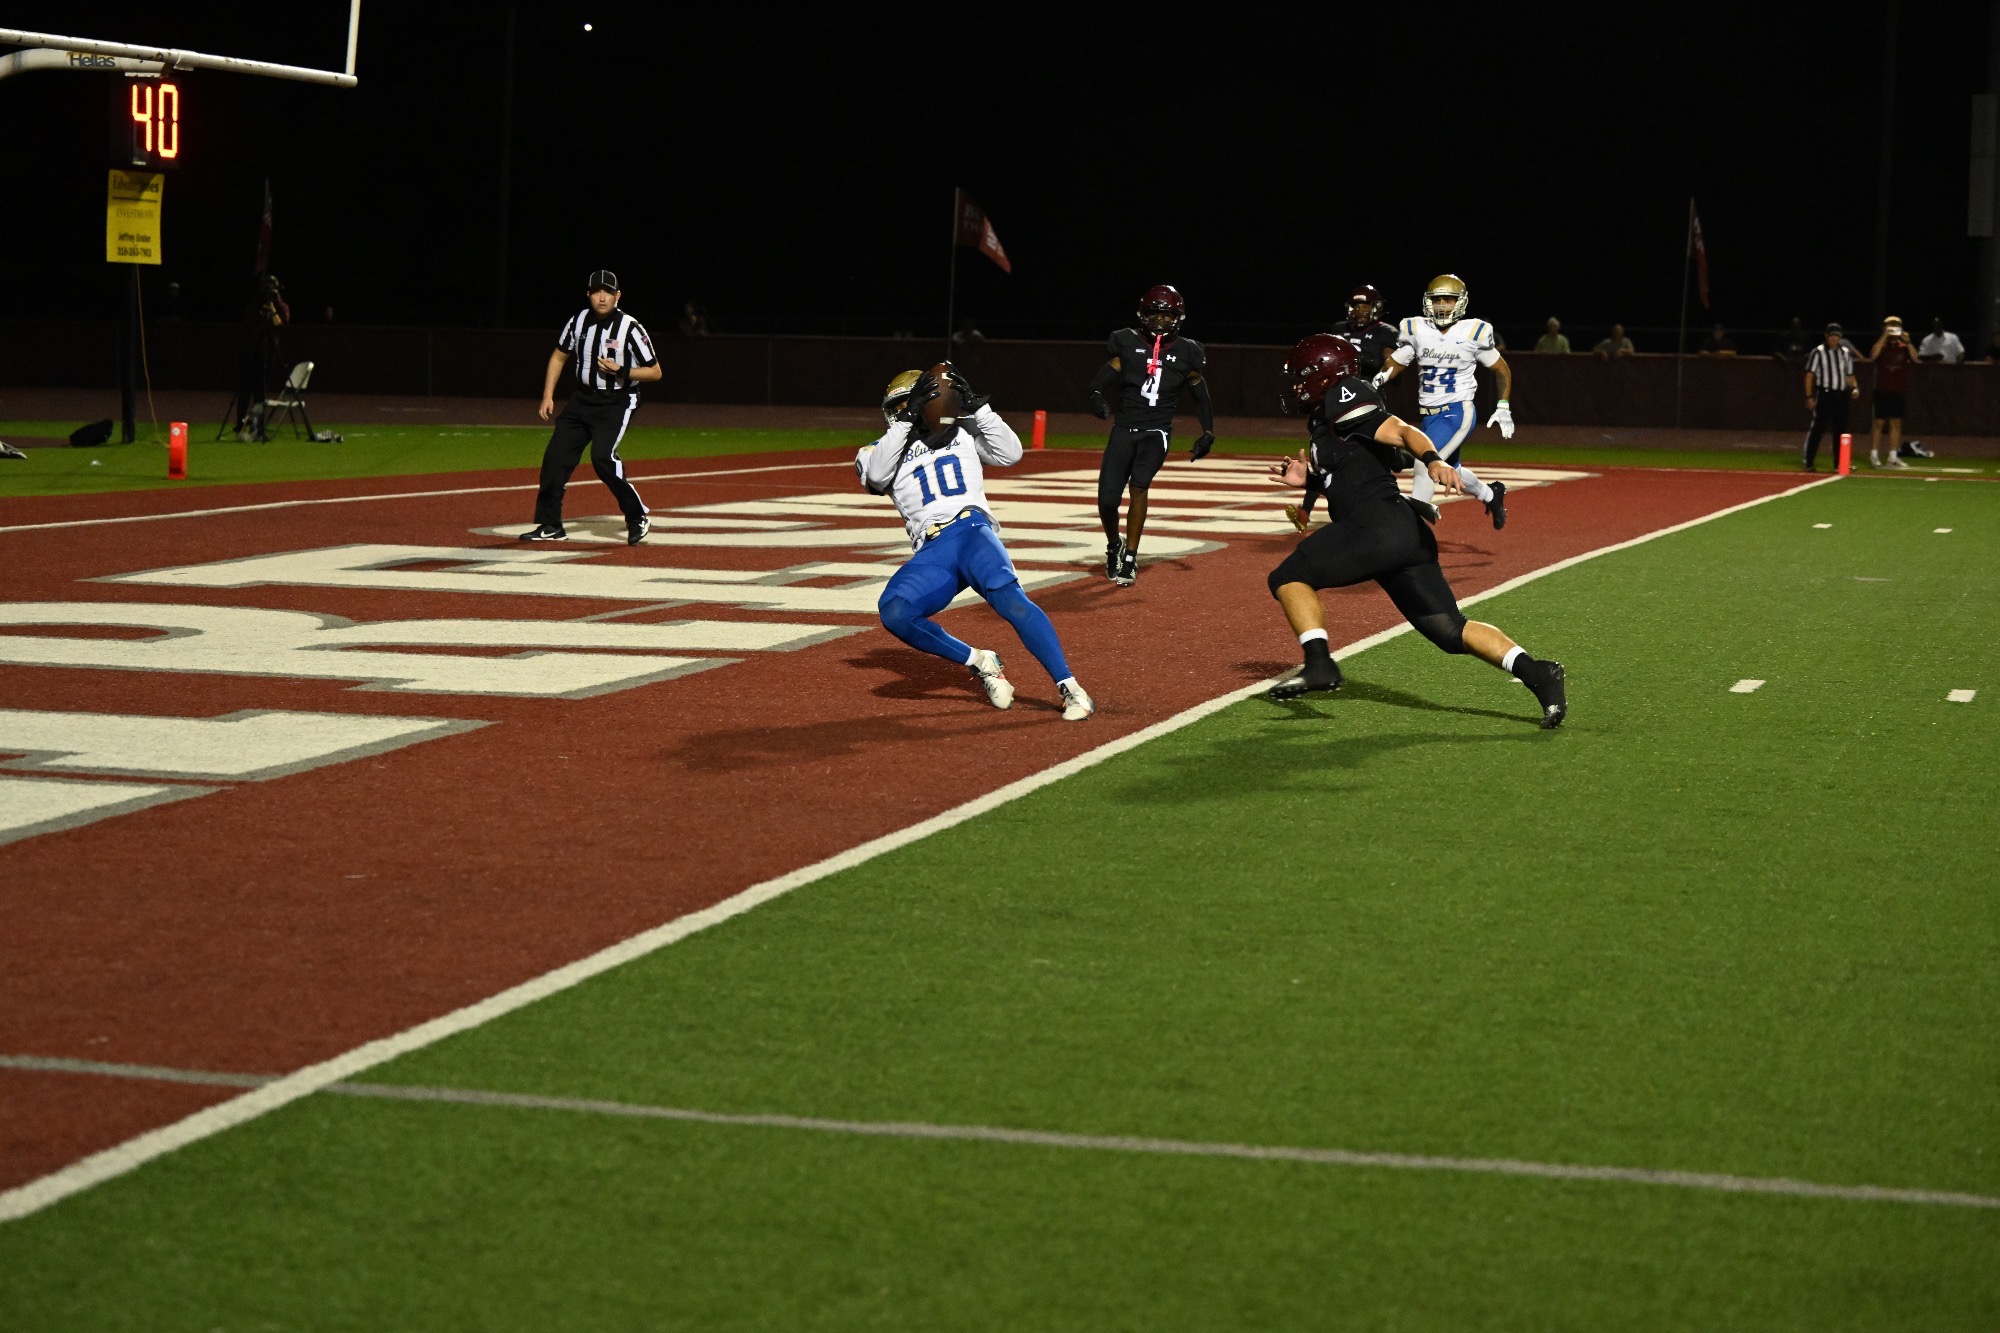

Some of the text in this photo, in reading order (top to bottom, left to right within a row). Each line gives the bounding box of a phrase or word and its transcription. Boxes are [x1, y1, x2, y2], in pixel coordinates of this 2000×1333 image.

[70, 53, 115, 67] Hellas
[132, 84, 178, 157] 40
[1420, 347, 1461, 364] Bluejays
[1141, 367, 1162, 407] 4
[1422, 365, 1458, 393] 24
[913, 454, 967, 507] 10
